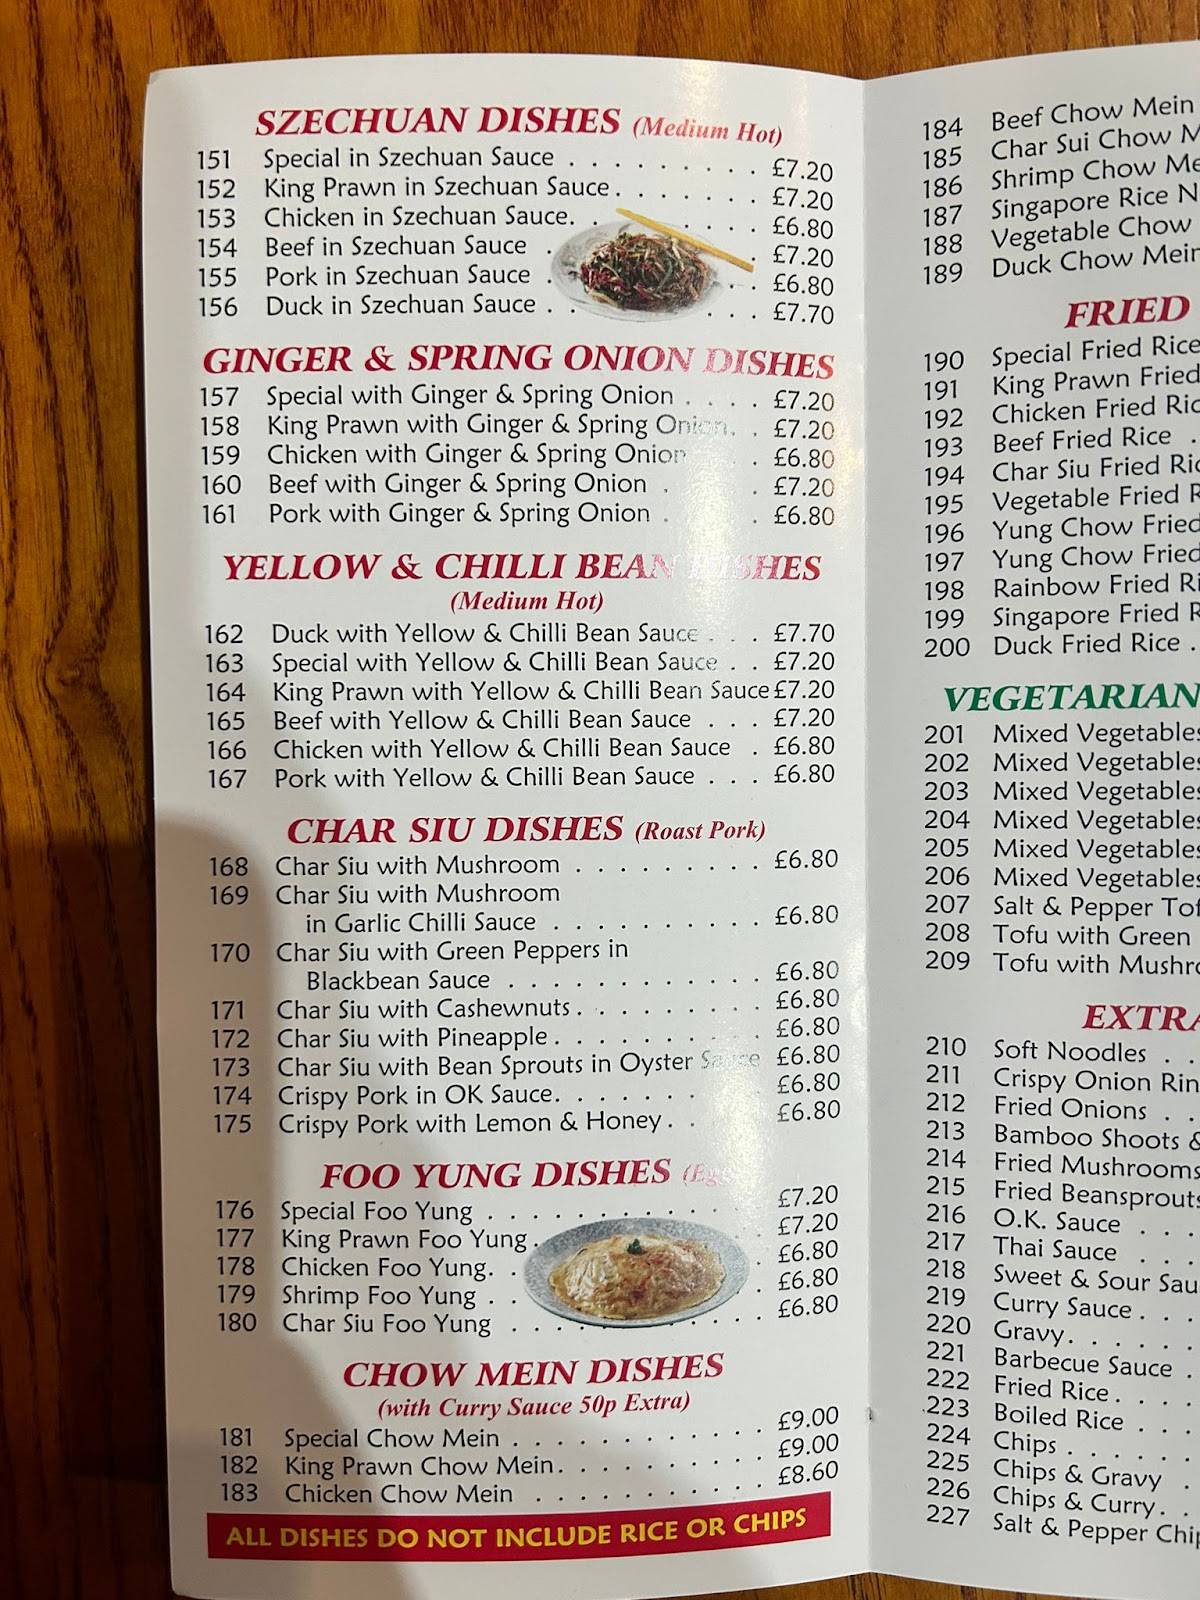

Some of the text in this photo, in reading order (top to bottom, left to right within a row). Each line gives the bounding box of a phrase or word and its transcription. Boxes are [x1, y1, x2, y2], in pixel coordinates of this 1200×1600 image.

[255, 106, 782, 148] SZECHUAN DISHES (Medium Hot)
[923, 95, 1194, 141] 184 Beef Chow Mein
[198, 146, 833, 183] 151 Special in Szechuan Sauce £7.20
[924, 215, 1192, 256] 188 Vegetable Chow
[199, 293, 834, 325] 156 Duck in Szechuan Sauce £7.70
[1064, 295, 1190, 328] FRIED
[203, 344, 834, 380] GINGER & SPRING ONION DISHES
[200, 383, 834, 412] 157 Special with Ginger & Spring Onion £7.20
[925, 426, 1171, 458] 193 Beef Fried Rice
[223, 554, 383, 580] YELLOW
[391, 553, 423, 580] &
[435, 553, 567, 579] CHILLI
[575, 553, 678, 579] BEAN
[451, 591, 603, 614] (Medium Hot)
[924, 632, 1180, 658] 200 Duck Fried Rice
[207, 680, 835, 707] 164 King Prawn with Yellow & Chilli Bean Sauce £7.20
[944, 683, 1200, 712] VEGETARIAN
[209, 764, 835, 789] 167 Pork with Yellow & Chilli Bean Sauce £6.80
[288, 816, 765, 844] CHAR SIU DISHES (Roast Pork)
[210, 849, 838, 876] 168 Char Siu with Mushroom £6.80
[925, 922, 1190, 946] 208 Tofu with Green
[212, 939, 628, 964] 170 Char Siu with Green Peppers in
[307, 960, 839, 991] Blackbean Sauce £6.80
[926, 1036, 1146, 1063] 210 Soft Noodles
[214, 1099, 840, 1139] 175 Crispy Pork with Lemon & Honey £6.80
[320, 1164, 400, 1189] FOO
[413, 1163, 521, 1189] YUNG
[531, 1158, 671, 1187] DISHES
[927, 1231, 1117, 1261] 217 Thai Sauce
[344, 1353, 724, 1387] CHOW MEIN DISHES
[927, 1341, 1172, 1378] 221 Barbecue Sauce
[378, 1391, 690, 1421] (with Curry Sauce 50p Extra)
[221, 1406, 839, 1453] 181 Special Chow Mein £9.00
[222, 1460, 838, 1504] 183 Chicken Chow Mein £8.60
[927, 1450, 1162, 1493] 225 Chips & Gravy
[226, 1507, 807, 1548] ALL DISHES DO NOT INCLUDE RICE OR CHIPS
[927, 1504, 1148, 1545] 227 Salt & Pepper
